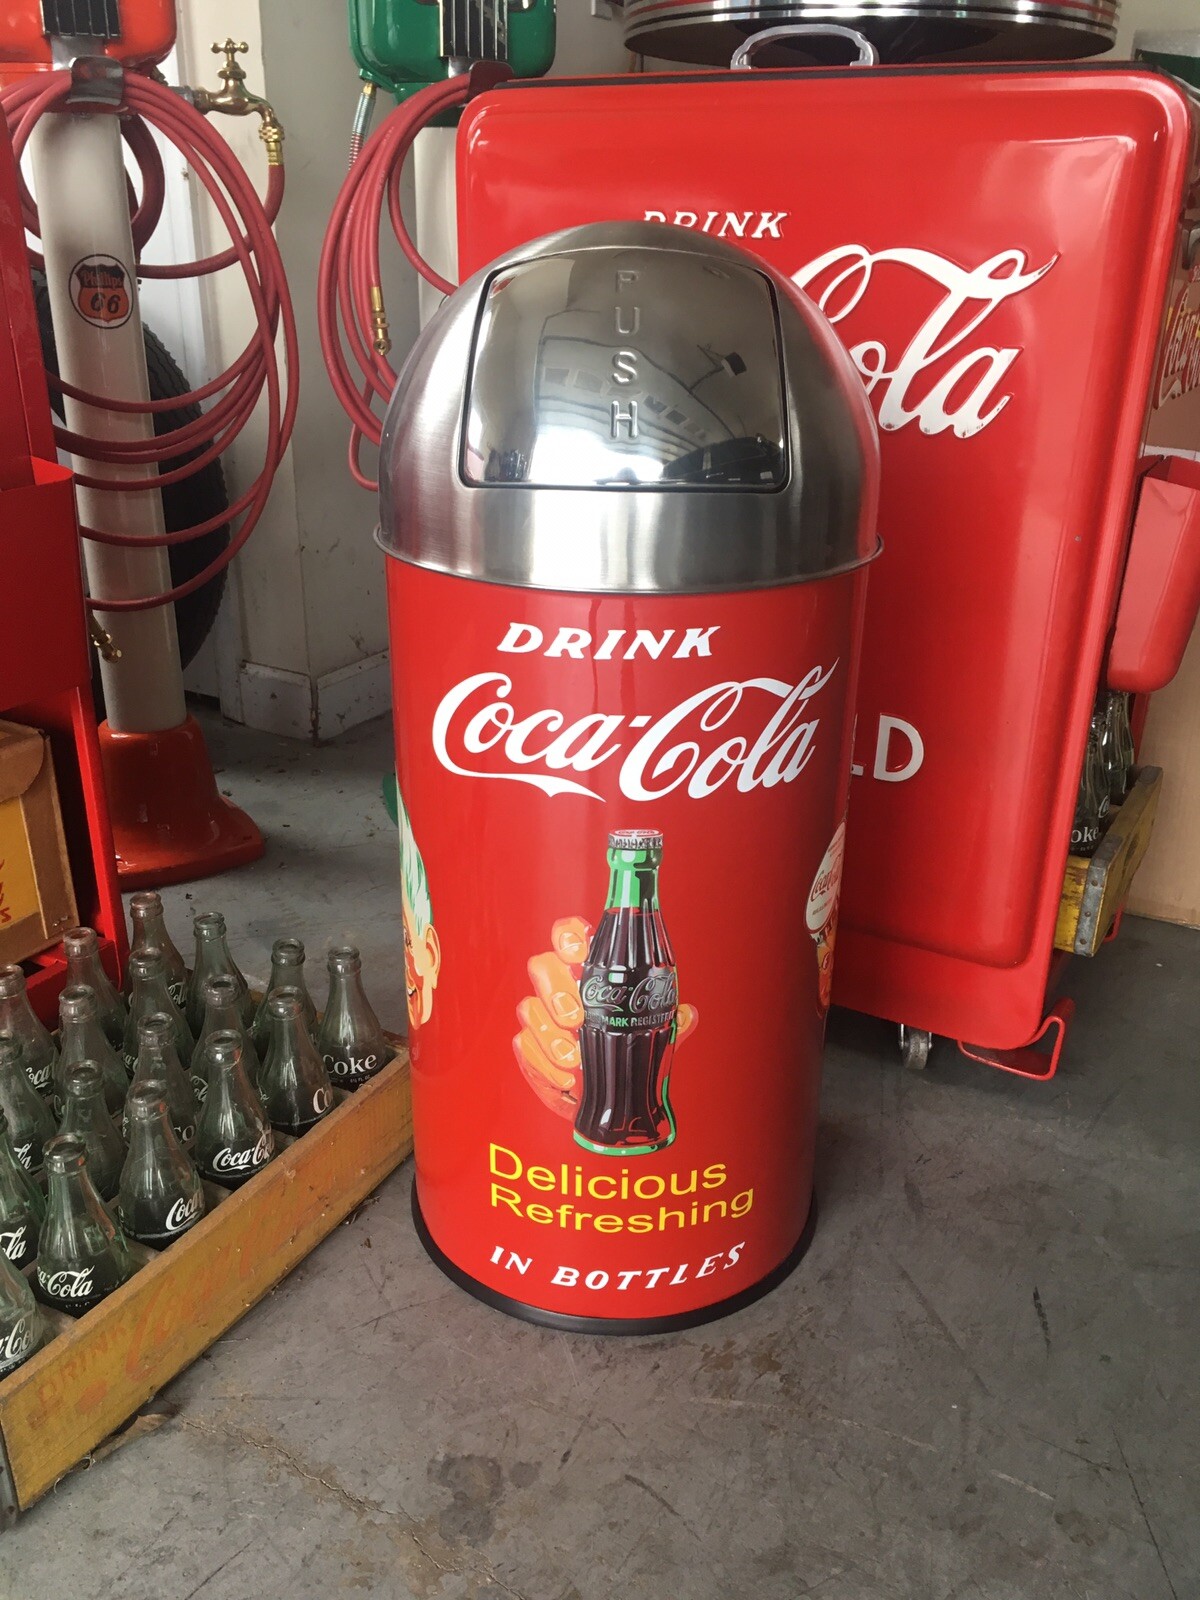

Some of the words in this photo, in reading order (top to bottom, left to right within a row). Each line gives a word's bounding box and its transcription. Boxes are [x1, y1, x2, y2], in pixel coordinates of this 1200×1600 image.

[90, 291, 121, 314] 66
[610, 269, 642, 441] PUSH
[496, 621, 721, 661] DRINK
[431, 656, 841, 804] Coca-Cola
[1070, 826, 1100, 844] oke
[582, 973, 676, 1014] Coca-Cola
[322, 1054, 378, 1076] Coke
[489, 1142, 728, 1201] Delicious
[490, 1182, 755, 1234] Refreshing
[488, 1245, 533, 1276] IN
[549, 1240, 746, 1291] BOTTLES
